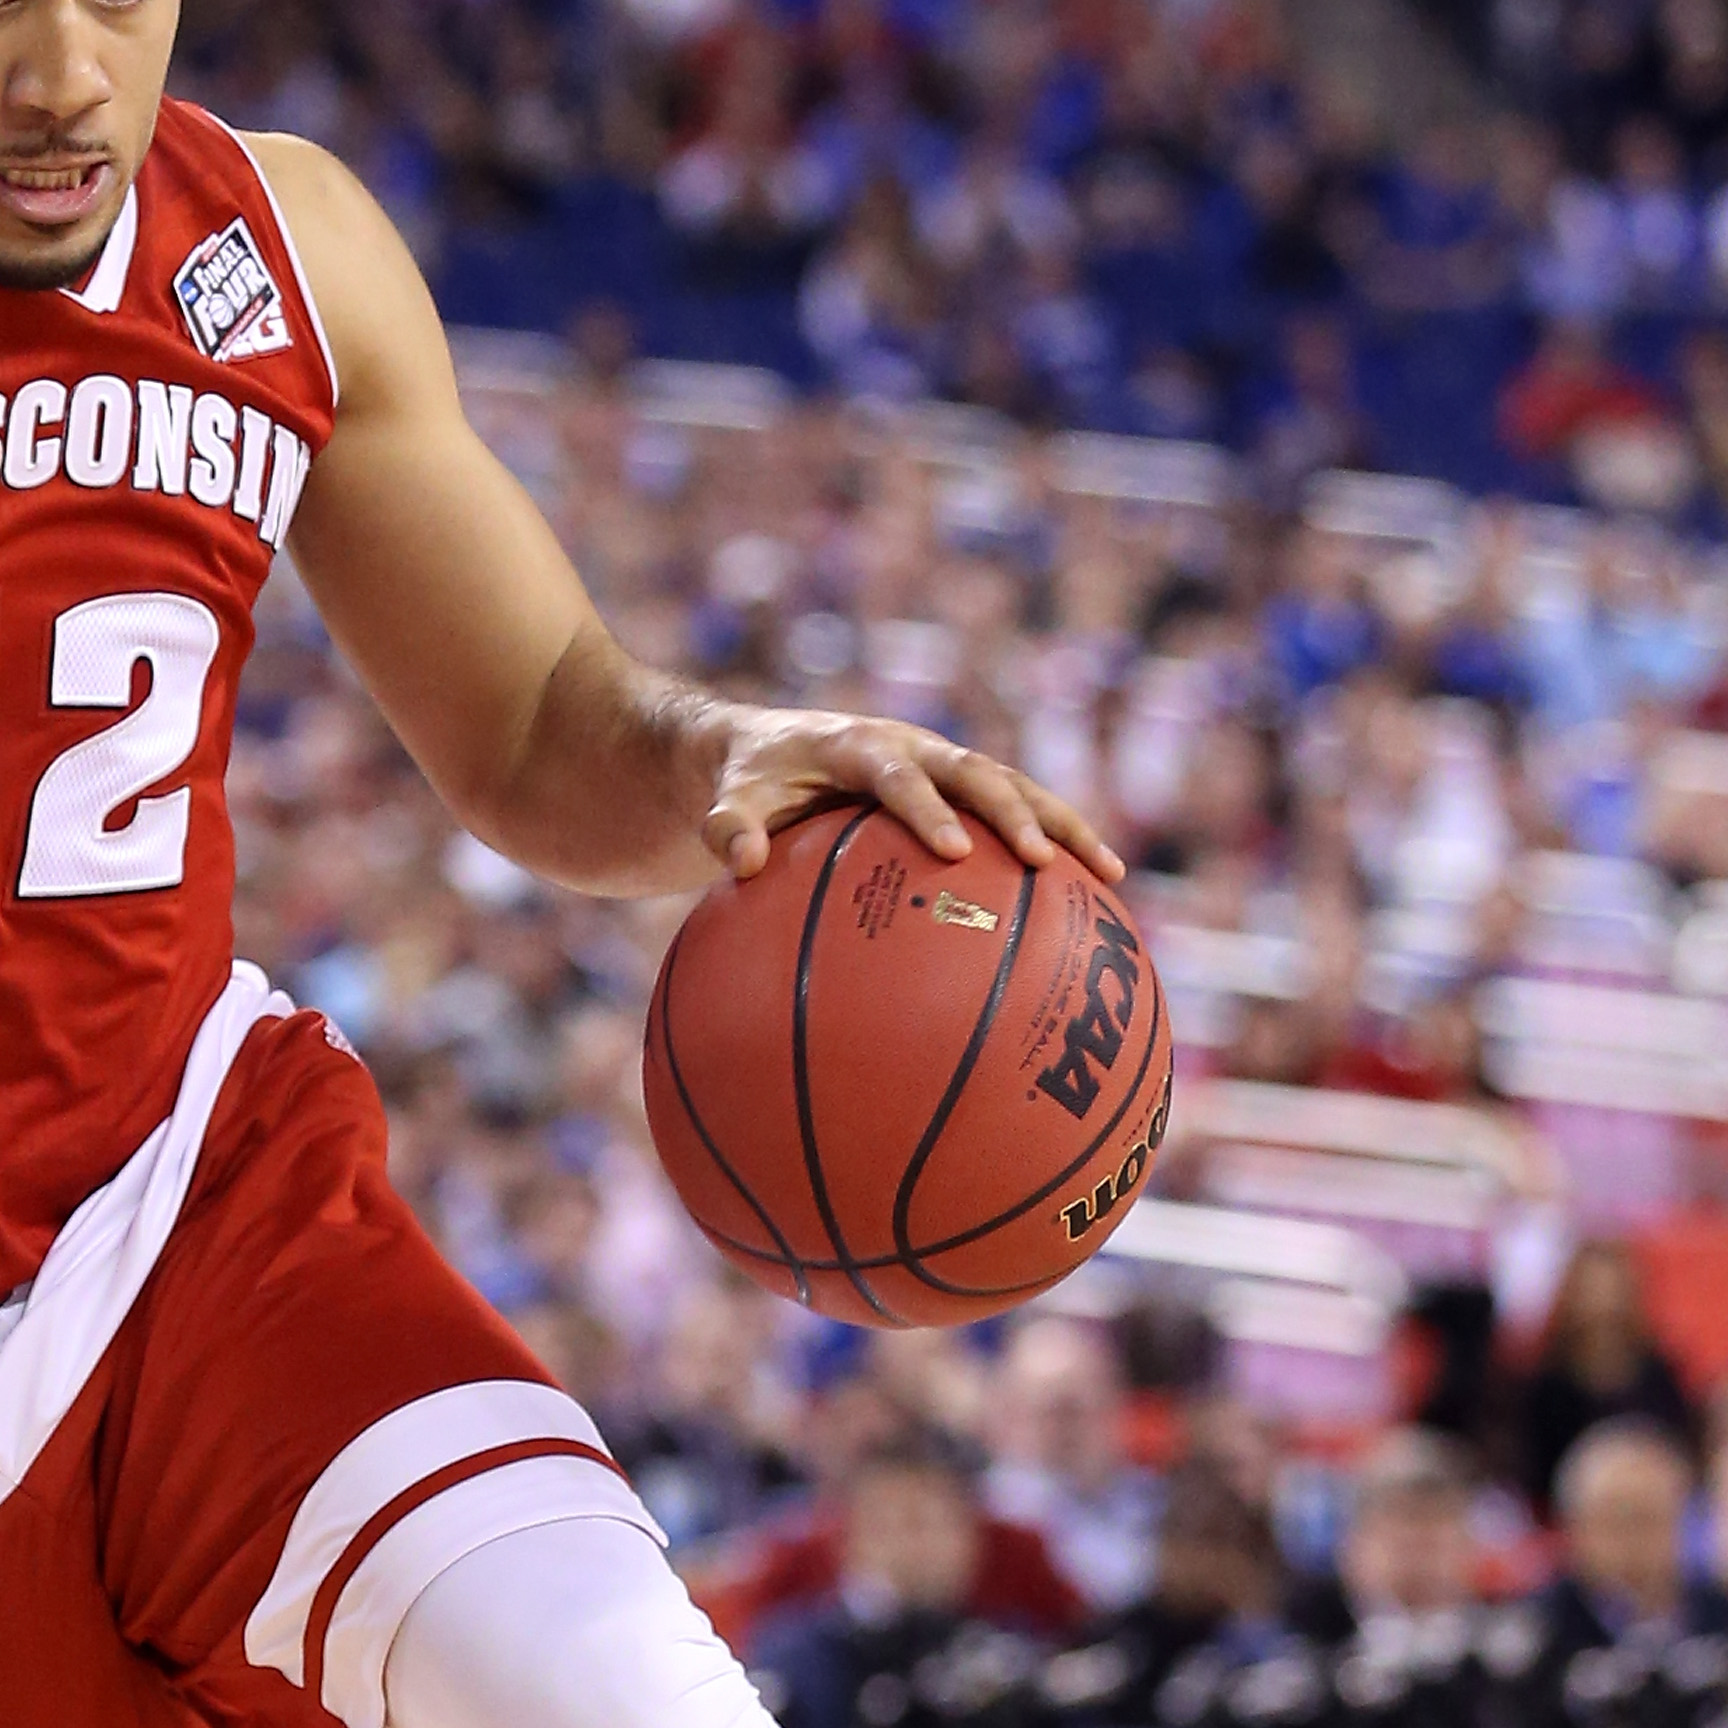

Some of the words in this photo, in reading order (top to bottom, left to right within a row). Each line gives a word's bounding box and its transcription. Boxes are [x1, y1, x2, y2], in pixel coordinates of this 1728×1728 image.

[192, 237, 247, 298] FINAL
[192, 256, 269, 349] FOUR
[1035, 892, 1139, 1120] NCAA
